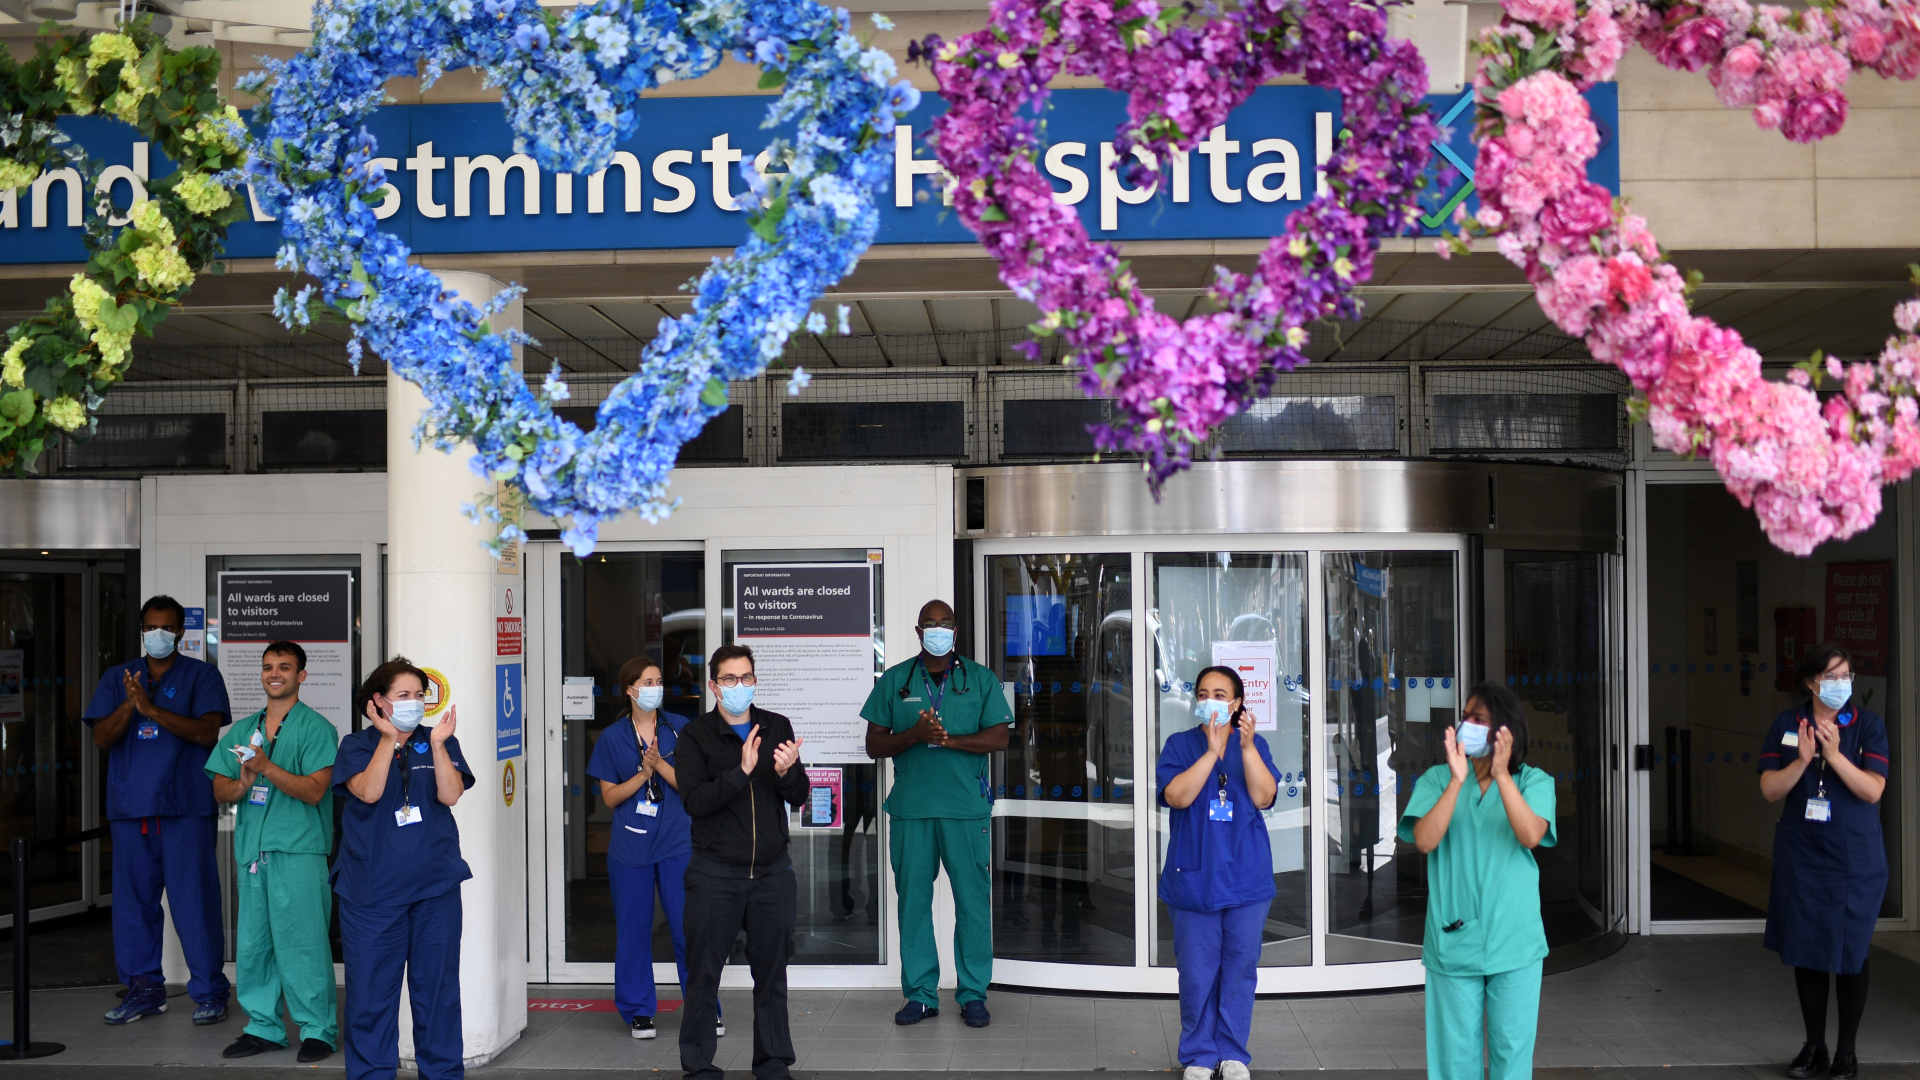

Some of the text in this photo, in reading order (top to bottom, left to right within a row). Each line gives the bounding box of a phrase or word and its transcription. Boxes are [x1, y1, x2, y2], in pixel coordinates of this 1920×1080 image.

[0, 142, 149, 228] nd
[895, 112, 1333, 230] Hspital
[1834, 571, 1883, 587] Please do not
[744, 586, 758, 596] All
[761, 586, 794, 596] wards
[817, 585, 851, 595] closed
[227, 593, 242, 602] All
[244, 592, 276, 602] wards
[298, 592, 330, 602] closed
[1836, 589, 1879, 604] wear scrubs
[744, 600, 797, 610] to visitors
[241, 606, 278, 616] visitors
[1838, 606, 1875, 621] outside of
[497, 622, 521, 633] NO SMOKING
[1835, 623, 1877, 644] the hospital
[498, 728, 520, 738] Disabled access
[527, 1002, 594, 1010] ntry
